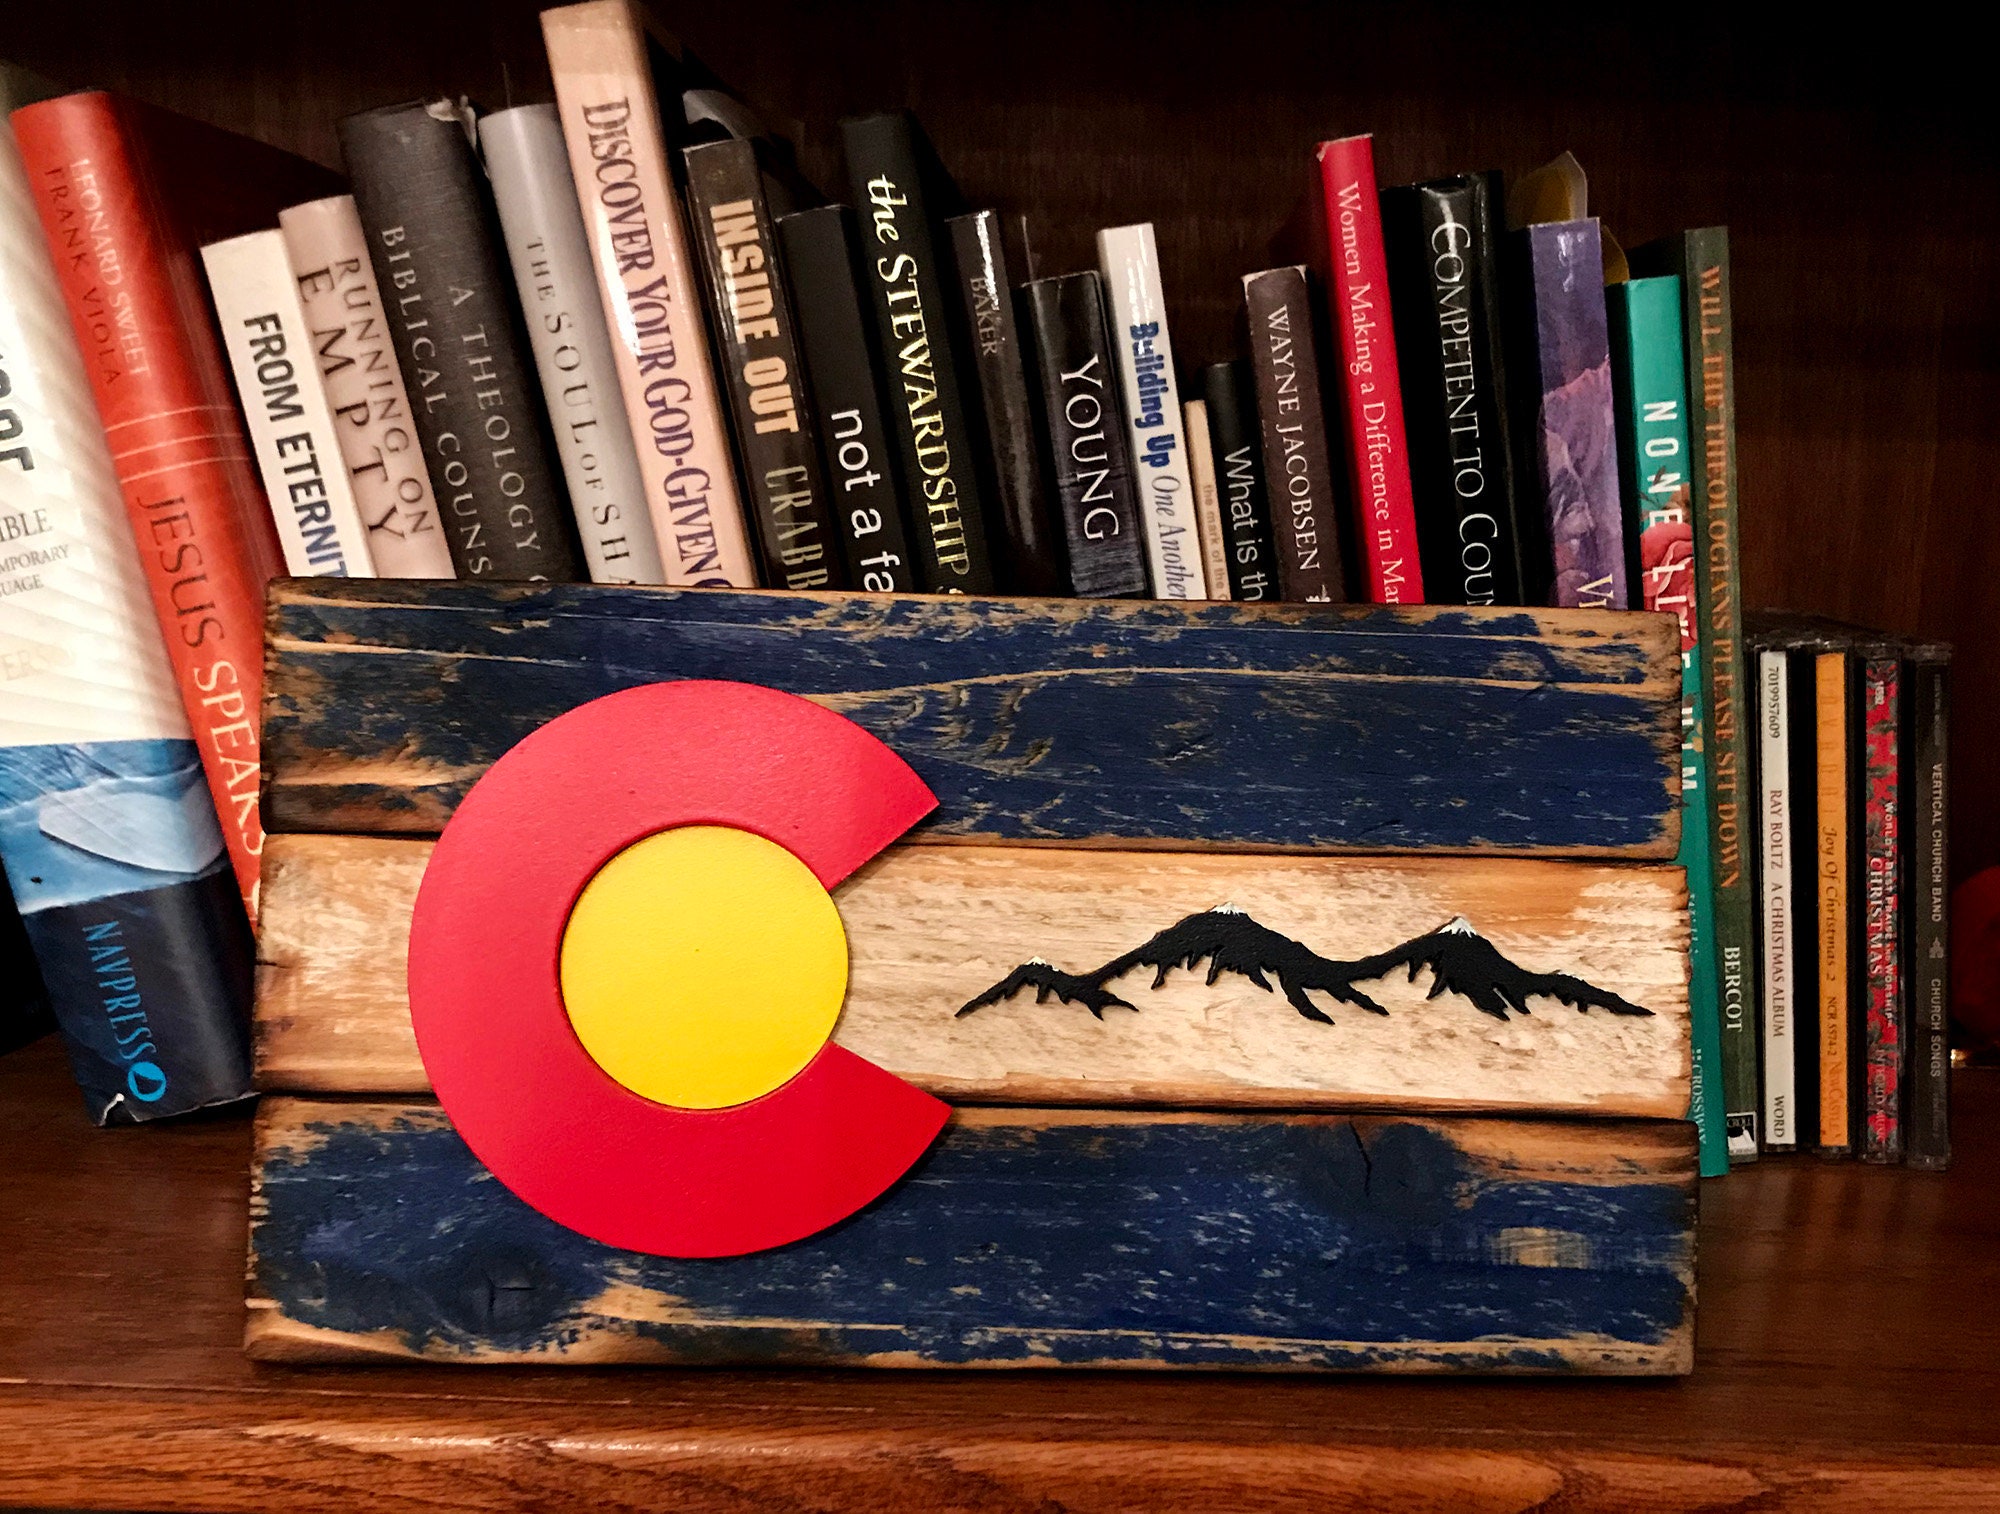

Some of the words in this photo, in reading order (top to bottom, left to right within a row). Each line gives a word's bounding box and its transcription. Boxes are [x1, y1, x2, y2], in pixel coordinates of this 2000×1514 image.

[581, 95, 656, 275] DISCOVER
[866, 173, 908, 245] the
[69, 158, 122, 286] LEONARD
[108, 291, 150, 375] SWEET
[1335, 181, 1361, 275] Women
[44, 167, 91, 272] FRANK
[82, 287, 121, 385] VIOLA
[448, 284, 476, 306] A
[709, 199, 780, 344] INSIDE
[1701, 265, 1722, 347] WILL
[627, 275, 678, 377] YOUR
[970, 277, 998, 356] BAKER
[1349, 282, 1375, 377] Making
[1431, 221, 1479, 439] COMPETENT
[243, 312, 305, 423] FROM
[335, 257, 410, 452] RUNNING
[397, 475, 435, 536] ON
[381, 226, 447, 414] BIBLICAL
[436, 431, 493, 575] COUNS
[743, 355, 800, 435] OUT
[1129, 321, 1169, 429] Building
[1267, 304, 1300, 415] WAYNE
[1360, 381, 1374, 394] a
[1703, 351, 1725, 410] THE
[298, 267, 405, 541] EMPTY
[461, 323, 541, 553] THEOLOGY
[526, 236, 557, 303] THE
[544, 311, 598, 445] SOUL
[592, 502, 636, 584] SH
[876, 254, 970, 576] STEWARDSHIP
[643, 377, 723, 576] GOD-GIVEN
[830, 408, 882, 492] not
[1060, 353, 1119, 541] YOUNG
[1140, 433, 1176, 468] Up
[1223, 446, 1259, 531] What
[1362, 401, 1392, 520] Difference
[1453, 446, 1486, 499] TO
[1643, 400, 1683, 527] NONE
[764, 465, 829, 590] CRABB
[851, 507, 883, 539] a
[1151, 475, 1181, 517] One
[1203, 484, 1214, 506] the
[1206, 511, 1220, 545] mark
[1275, 424, 1320, 570] JACOBSEN
[1705, 417, 1733, 630] THEOLOGIANS
[136, 495, 224, 648] JESUS
[1211, 551, 1222, 563] of
[1213, 567, 1225, 589] the
[1236, 537, 1262, 564] is
[1377, 528, 1393, 551] in
[1240, 570, 1268, 600] th
[1713, 638, 1735, 744] PLEASE
[1768, 666, 1780, 739] 7019957609
[1716, 752, 1737, 793] SIT
[1770, 789, 1782, 818] RAY
[1931, 763, 1943, 826] VERTICAL
[1718, 803, 1741, 888] DOWN
[1770, 823, 1784, 870] BOLTZ
[1820, 827, 1837, 856] Joy
[1822, 861, 1840, 883] Of
[1931, 829, 1943, 883] CHURCH
[1771, 882, 1783, 892] A
[1825, 886, 1841, 967] Christmas
[1870, 857, 1884, 975] CHRISTMAS
[1931, 887, 1942, 922] BAND
[1771, 896, 1784, 983] CHRISTMAS
[81, 920, 158, 1062] NAVPRESS
[1724, 946, 1743, 1032] BERCOT
[1772, 986, 1785, 1038] ALBUM
[1931, 978, 1942, 1031] CHURCH
[1930, 1035, 1941, 1078] SONGS
[1773, 1095, 1785, 1138] WORD
